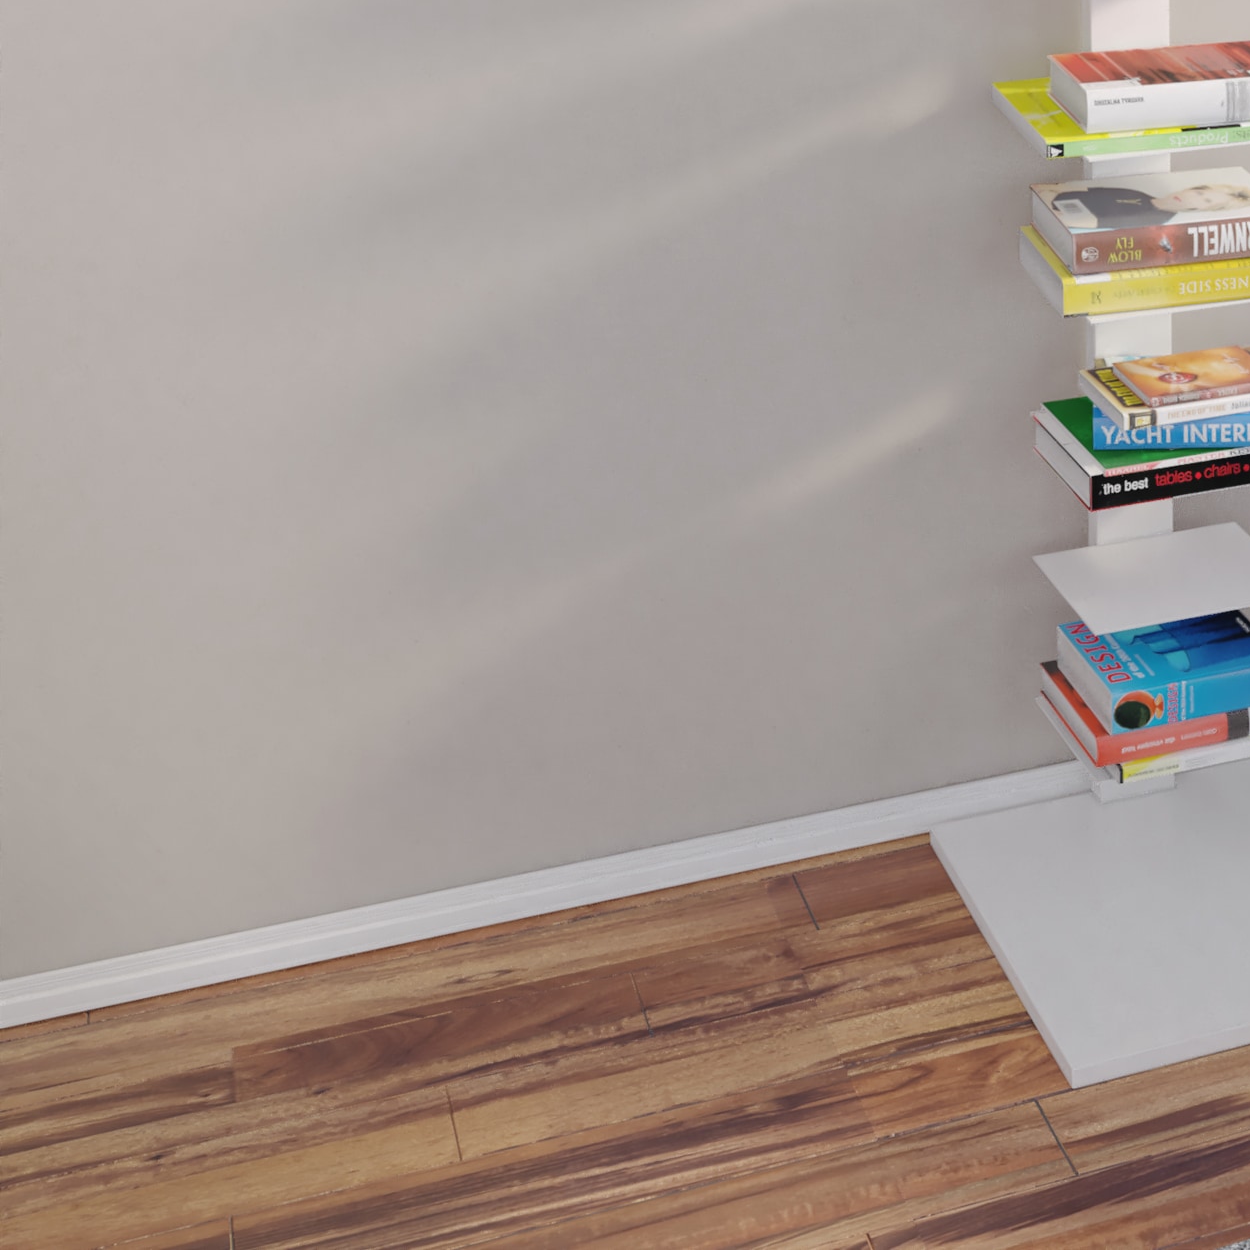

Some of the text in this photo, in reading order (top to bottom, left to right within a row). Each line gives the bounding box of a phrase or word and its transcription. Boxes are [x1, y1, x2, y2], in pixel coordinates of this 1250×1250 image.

[1169, 132, 1229, 146] Products
[1115, 236, 1134, 250] FLY
[1108, 250, 1142, 264] BLOW
[1179, 279, 1211, 295] SIDE
[1101, 423, 1174, 445] YACHT
[1103, 483, 1121, 496] the
[1124, 477, 1149, 493] best
[1154, 470, 1192, 487] tables
[1203, 462, 1241, 479] chairs
[1065, 623, 1132, 684] DESIGN
